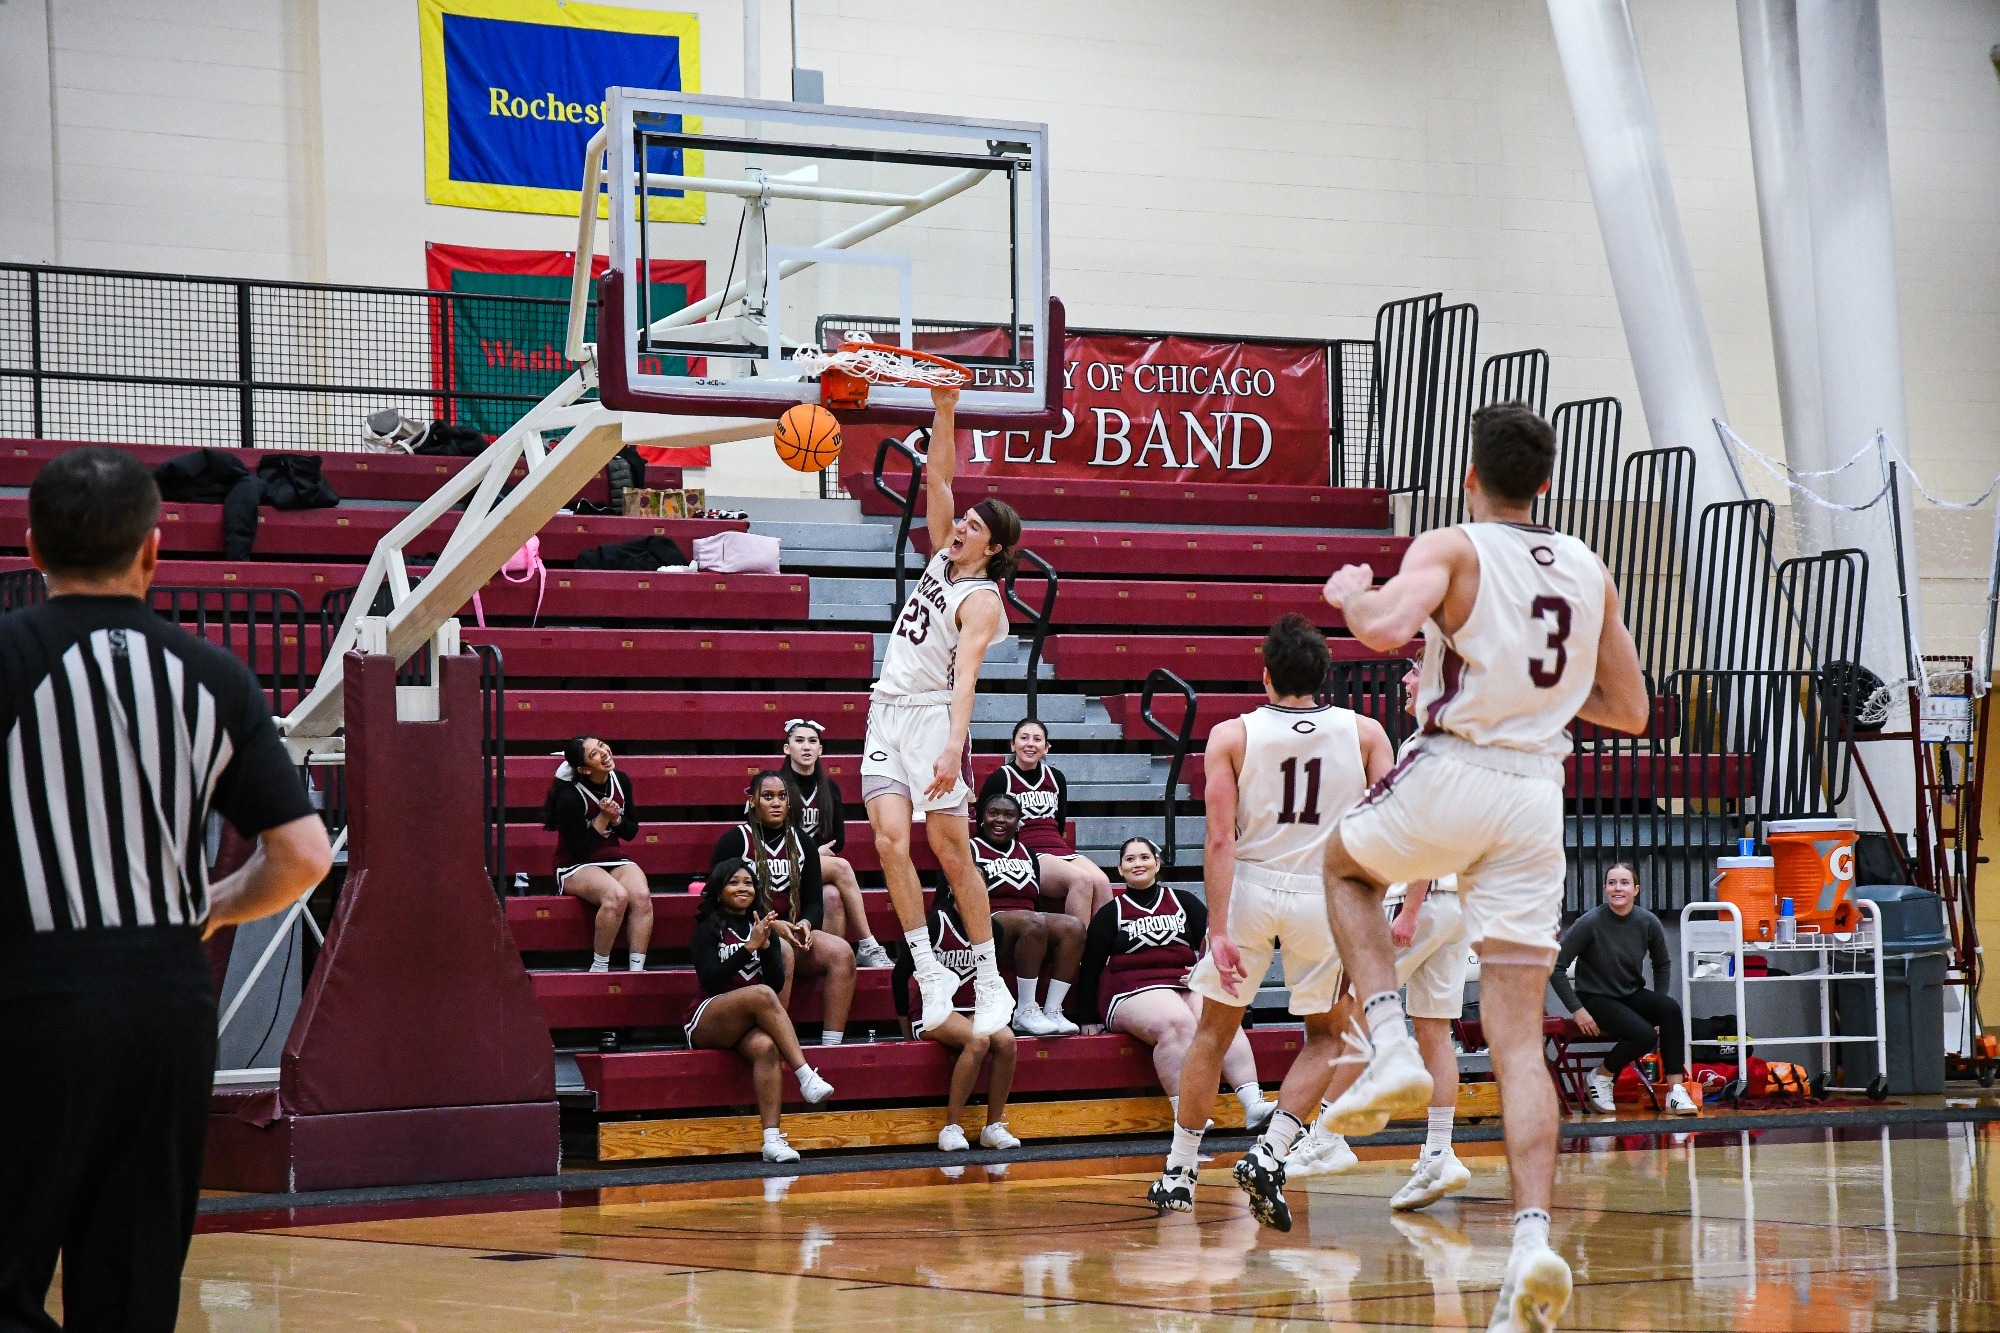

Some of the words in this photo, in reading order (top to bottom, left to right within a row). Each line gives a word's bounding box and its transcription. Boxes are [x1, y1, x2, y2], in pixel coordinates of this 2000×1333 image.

[489, 87, 608, 126] Rochest
[1086, 361, 1125, 392] OF
[1133, 363, 1275, 397] CHICAGO
[968, 406, 1076, 465] PEP
[1087, 406, 1273, 470] BAND
[896, 597, 931, 646] 23
[1528, 594, 1572, 689] 3
[1276, 756, 1322, 826] 11
[1829, 845, 1854, 881] G
[1127, 914, 1186, 941] MAROONS
